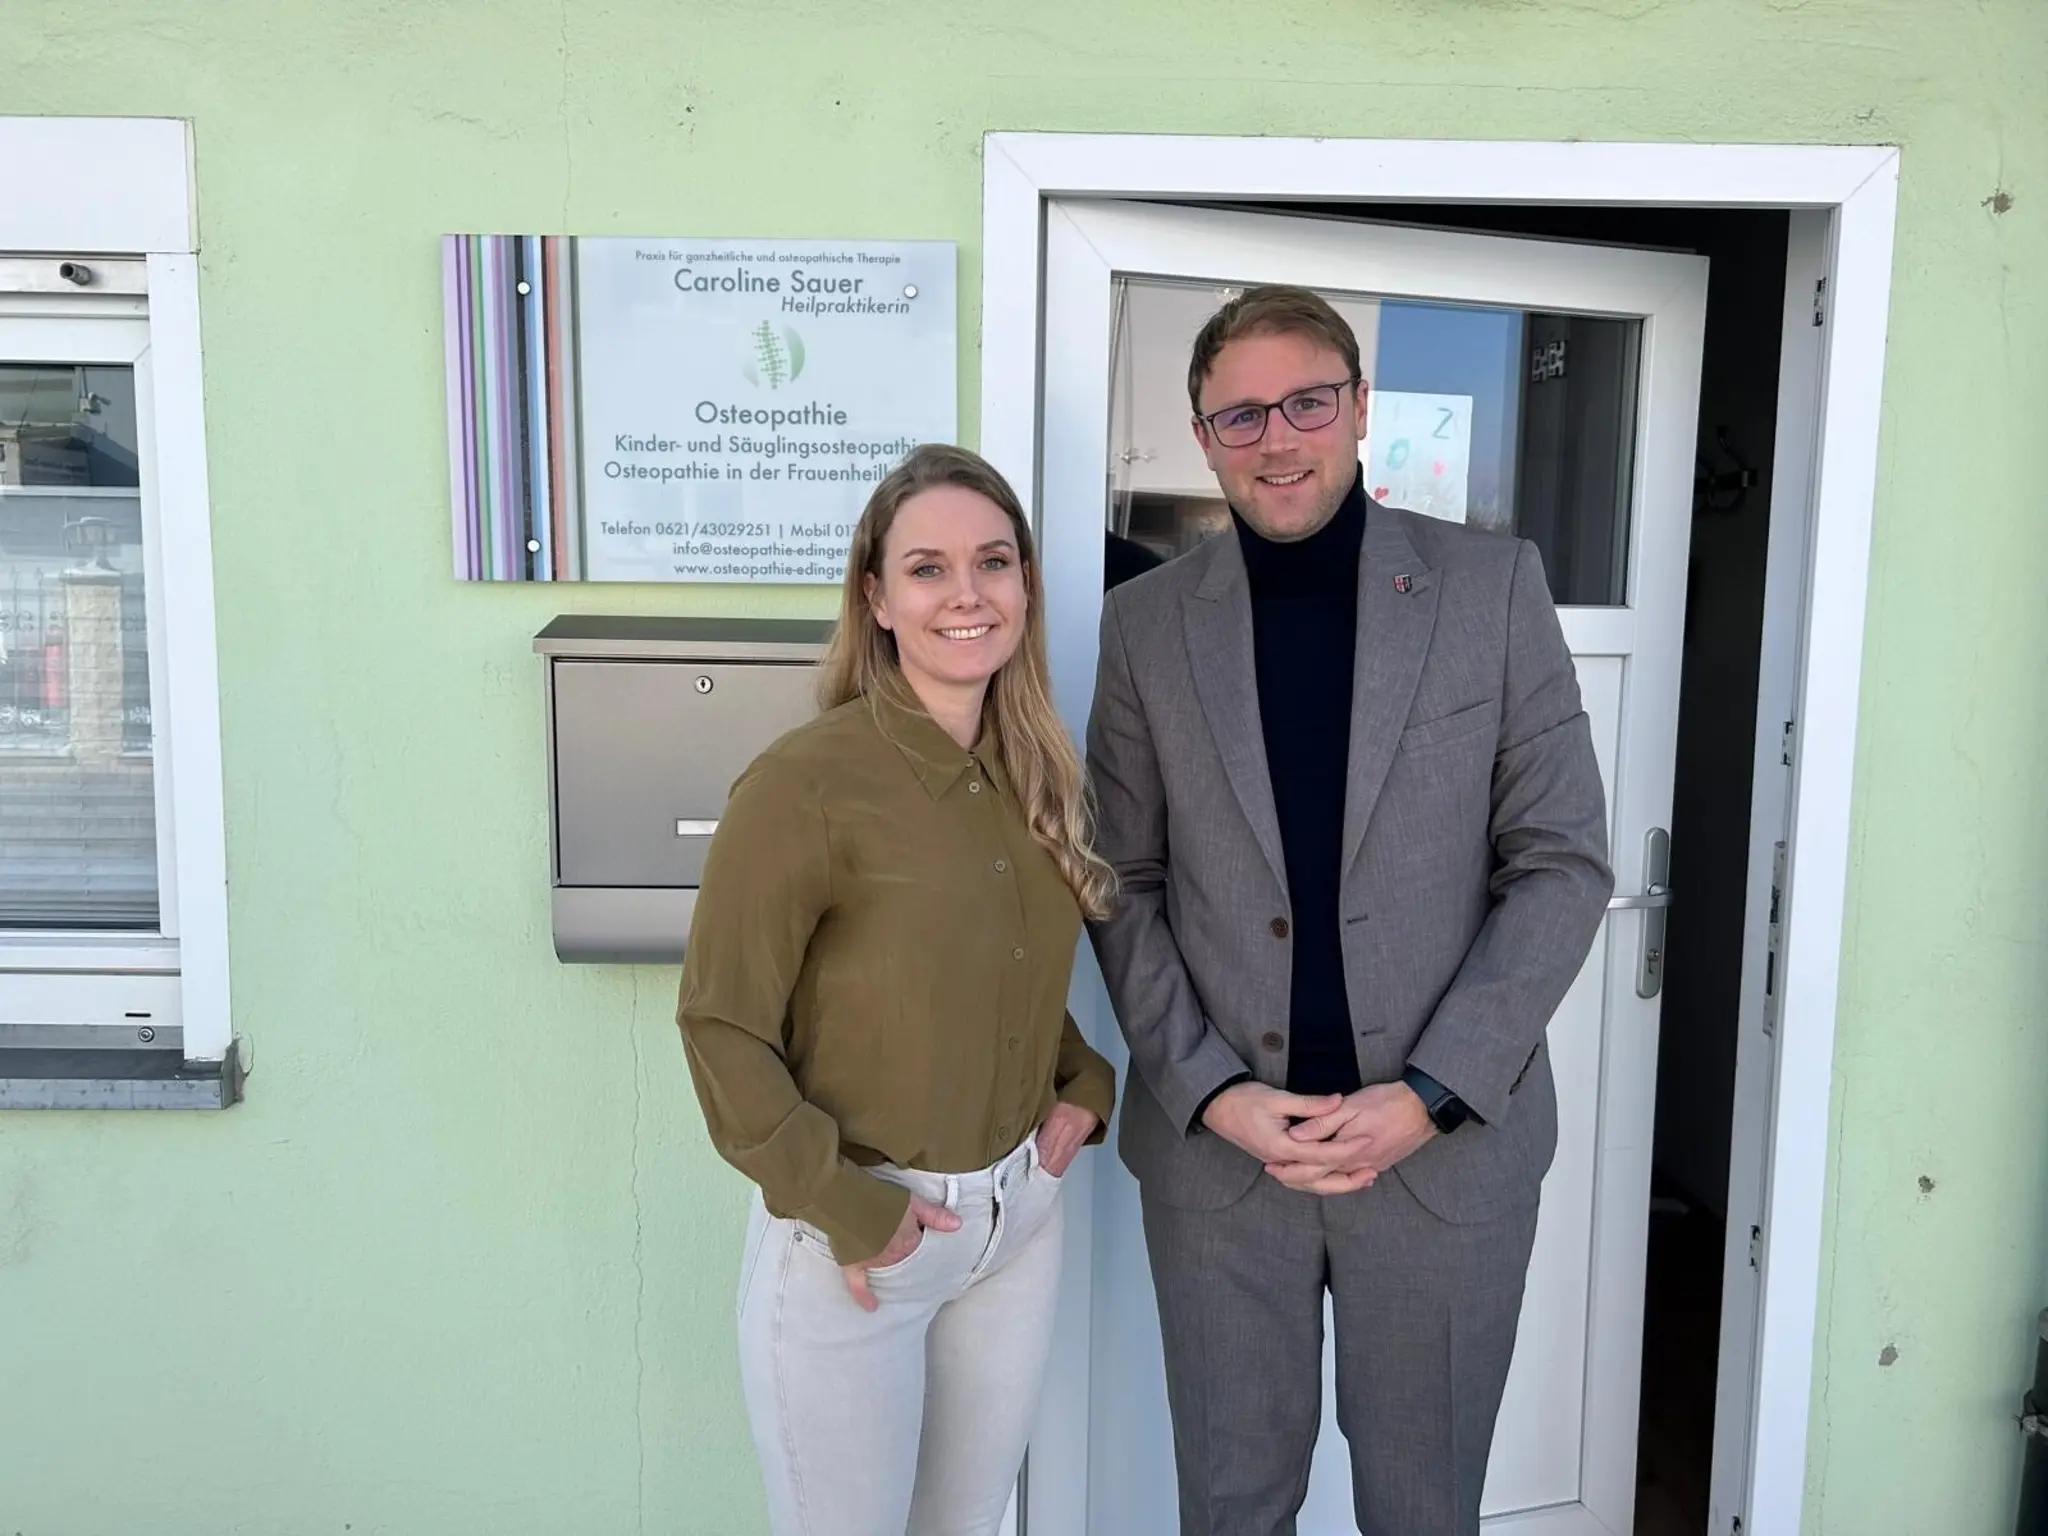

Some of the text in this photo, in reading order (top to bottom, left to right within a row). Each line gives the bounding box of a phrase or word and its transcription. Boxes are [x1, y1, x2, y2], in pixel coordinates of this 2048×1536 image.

[635, 250, 900, 266] Praxis für ganzheitliche und osteopathische Therapie
[674, 267, 863, 294] Caroline Sauer
[781, 295, 910, 318] Heilpraktikerin
[695, 400, 848, 432] Osteopathie
[615, 433, 918, 460] Kinder- und Säuglingsosteopathi
[604, 460, 720, 484] Osteopathie
[726, 463, 742, 480] in
[749, 461, 781, 481] der
[600, 521, 651, 535] Telefon
[655, 522, 770, 540] 0621/43029251
[790, 523, 830, 537] Mobil
[673, 561, 849, 580] www.osteopathie-edinge
